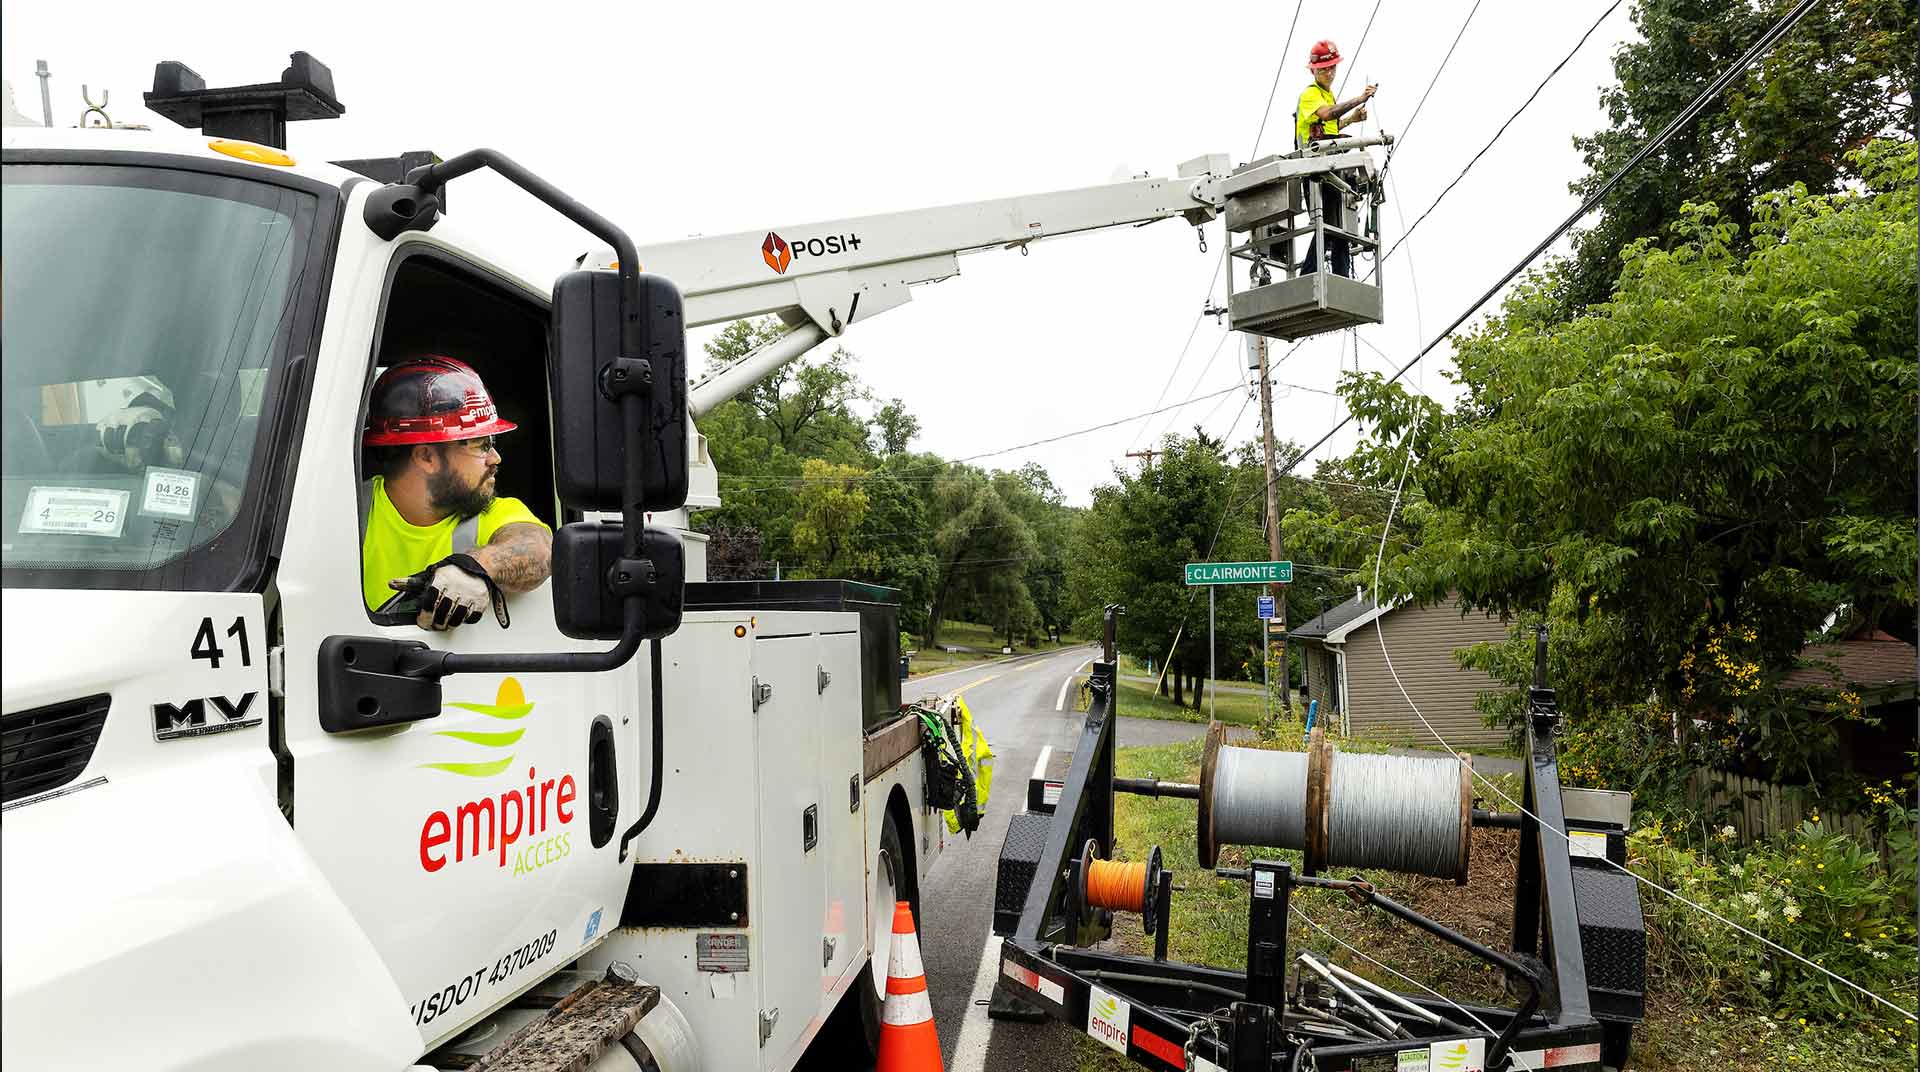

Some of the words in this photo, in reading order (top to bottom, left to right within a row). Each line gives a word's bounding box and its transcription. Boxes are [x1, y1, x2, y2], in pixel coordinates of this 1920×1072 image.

[791, 233, 861, 259] POSI+
[155, 483, 171, 495] 04
[174, 486, 190, 497] 26
[40, 508, 50, 520] 4
[93, 510, 115, 523] 26
[1187, 572, 1192, 580] E
[1194, 567, 1277, 579] CLAIRMONTE
[1280, 569, 1290, 577] ST
[190, 616, 251, 668] 41
[151, 691, 259, 731] MV
[420, 766, 576, 872] empire
[513, 832, 571, 877] ACCESS
[488, 929, 557, 986] 4370209
[1092, 1016, 1126, 1045] empire
